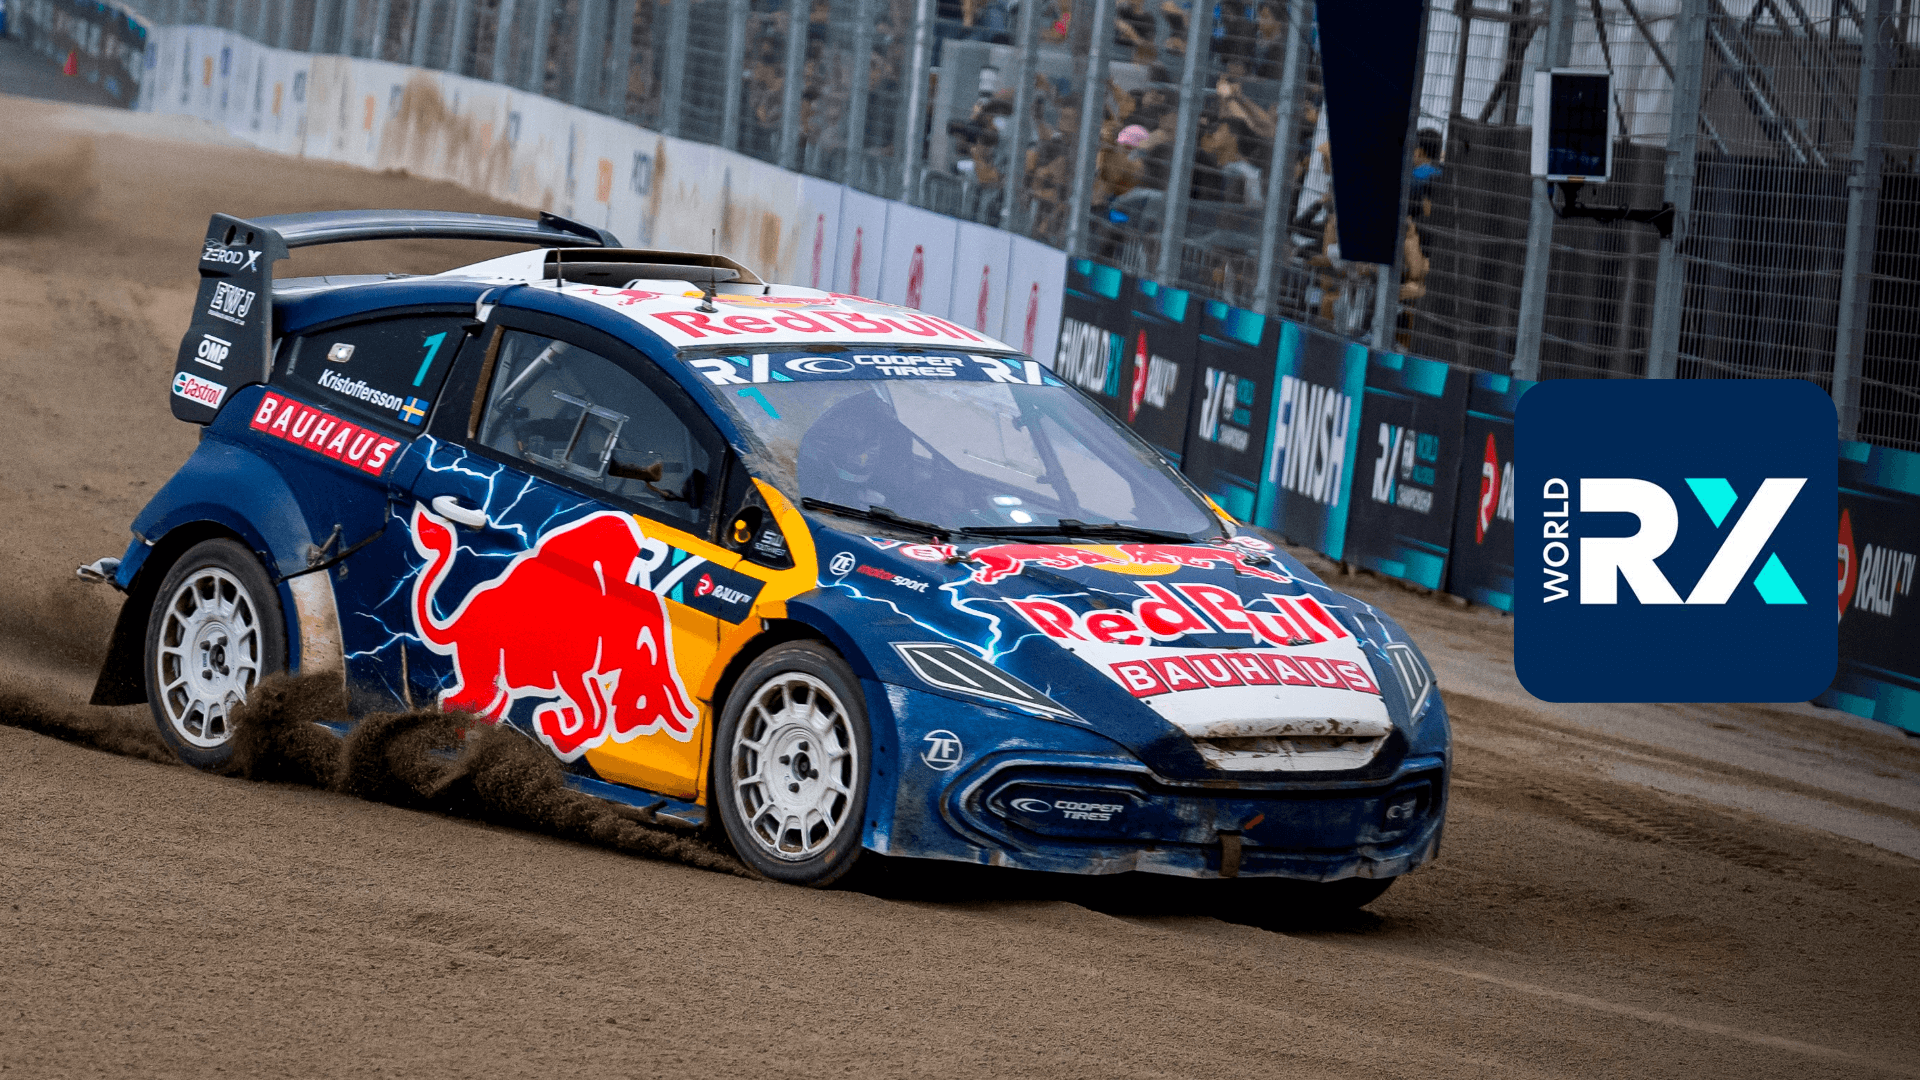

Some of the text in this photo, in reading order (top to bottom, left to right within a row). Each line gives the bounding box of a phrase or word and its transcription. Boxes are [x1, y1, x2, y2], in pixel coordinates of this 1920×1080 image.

[210, 281, 256, 317] EWJ
[653, 310, 984, 343] Red Bull
[198, 339, 229, 364] OMP
[412, 332, 447, 387] 1
[689, 354, 1065, 387] RX COOPER RX
[875, 365, 958, 377] TIRES
[184, 376, 222, 405] Castrol
[317, 369, 403, 411] Kristoffersson
[737, 386, 781, 421] 1
[255, 397, 395, 469] BAUHAUS
[1268, 374, 1351, 507] FINISH
[625, 537, 708, 603] RX
[831, 555, 853, 571] ZF
[711, 584, 743, 605] RALLY
[1854, 543, 1904, 618] RALLY
[1007, 581, 1350, 647] Red Bull
[1120, 652, 1375, 695] BAUHAUS
[924, 737, 961, 763] ZF
[1055, 800, 1123, 813] COOPER
[1063, 811, 1112, 822] TIRES
